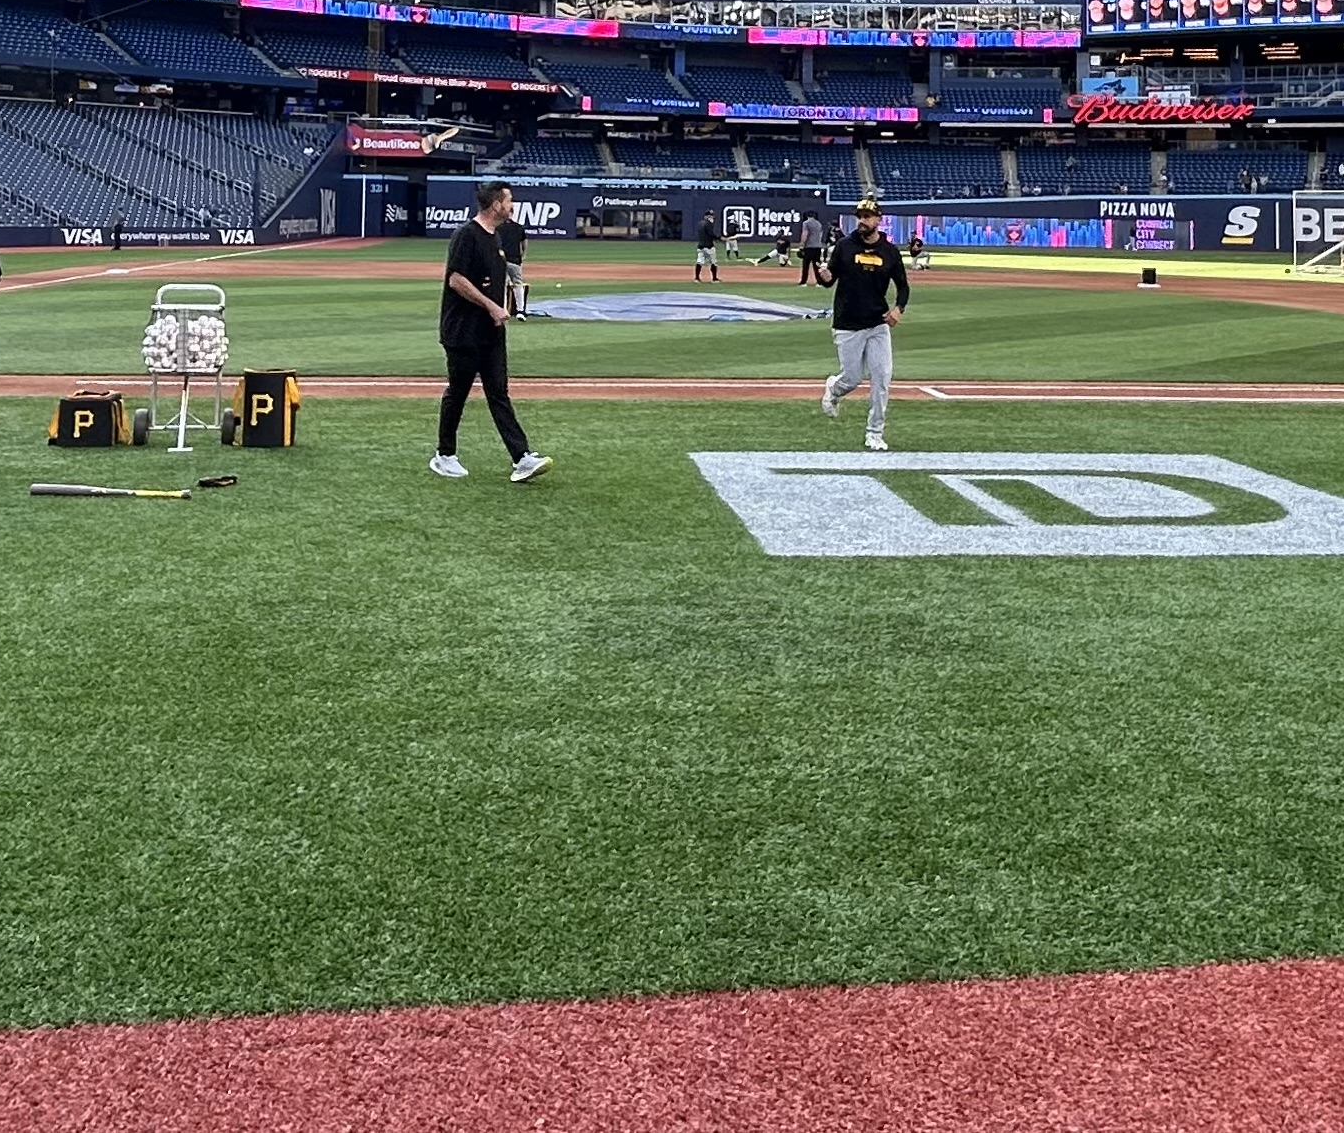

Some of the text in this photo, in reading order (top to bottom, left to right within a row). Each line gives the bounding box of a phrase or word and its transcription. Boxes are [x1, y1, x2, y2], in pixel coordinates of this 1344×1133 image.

[781, 106, 846, 118] TORONTO
[1074, 94, 1255, 124] Budweiser
[363, 137, 420, 150] BeautiTone
[605, 198, 667, 207] Pathways Alliance
[1100, 201, 1175, 218] PIZZA NOVA
[758, 208, 801, 223] Here's
[61, 228, 255, 245] VISA you want to be VISA
[1136, 230, 1155, 240] CITY
[250, 393, 274, 426] P
[73, 410, 94, 438] P
